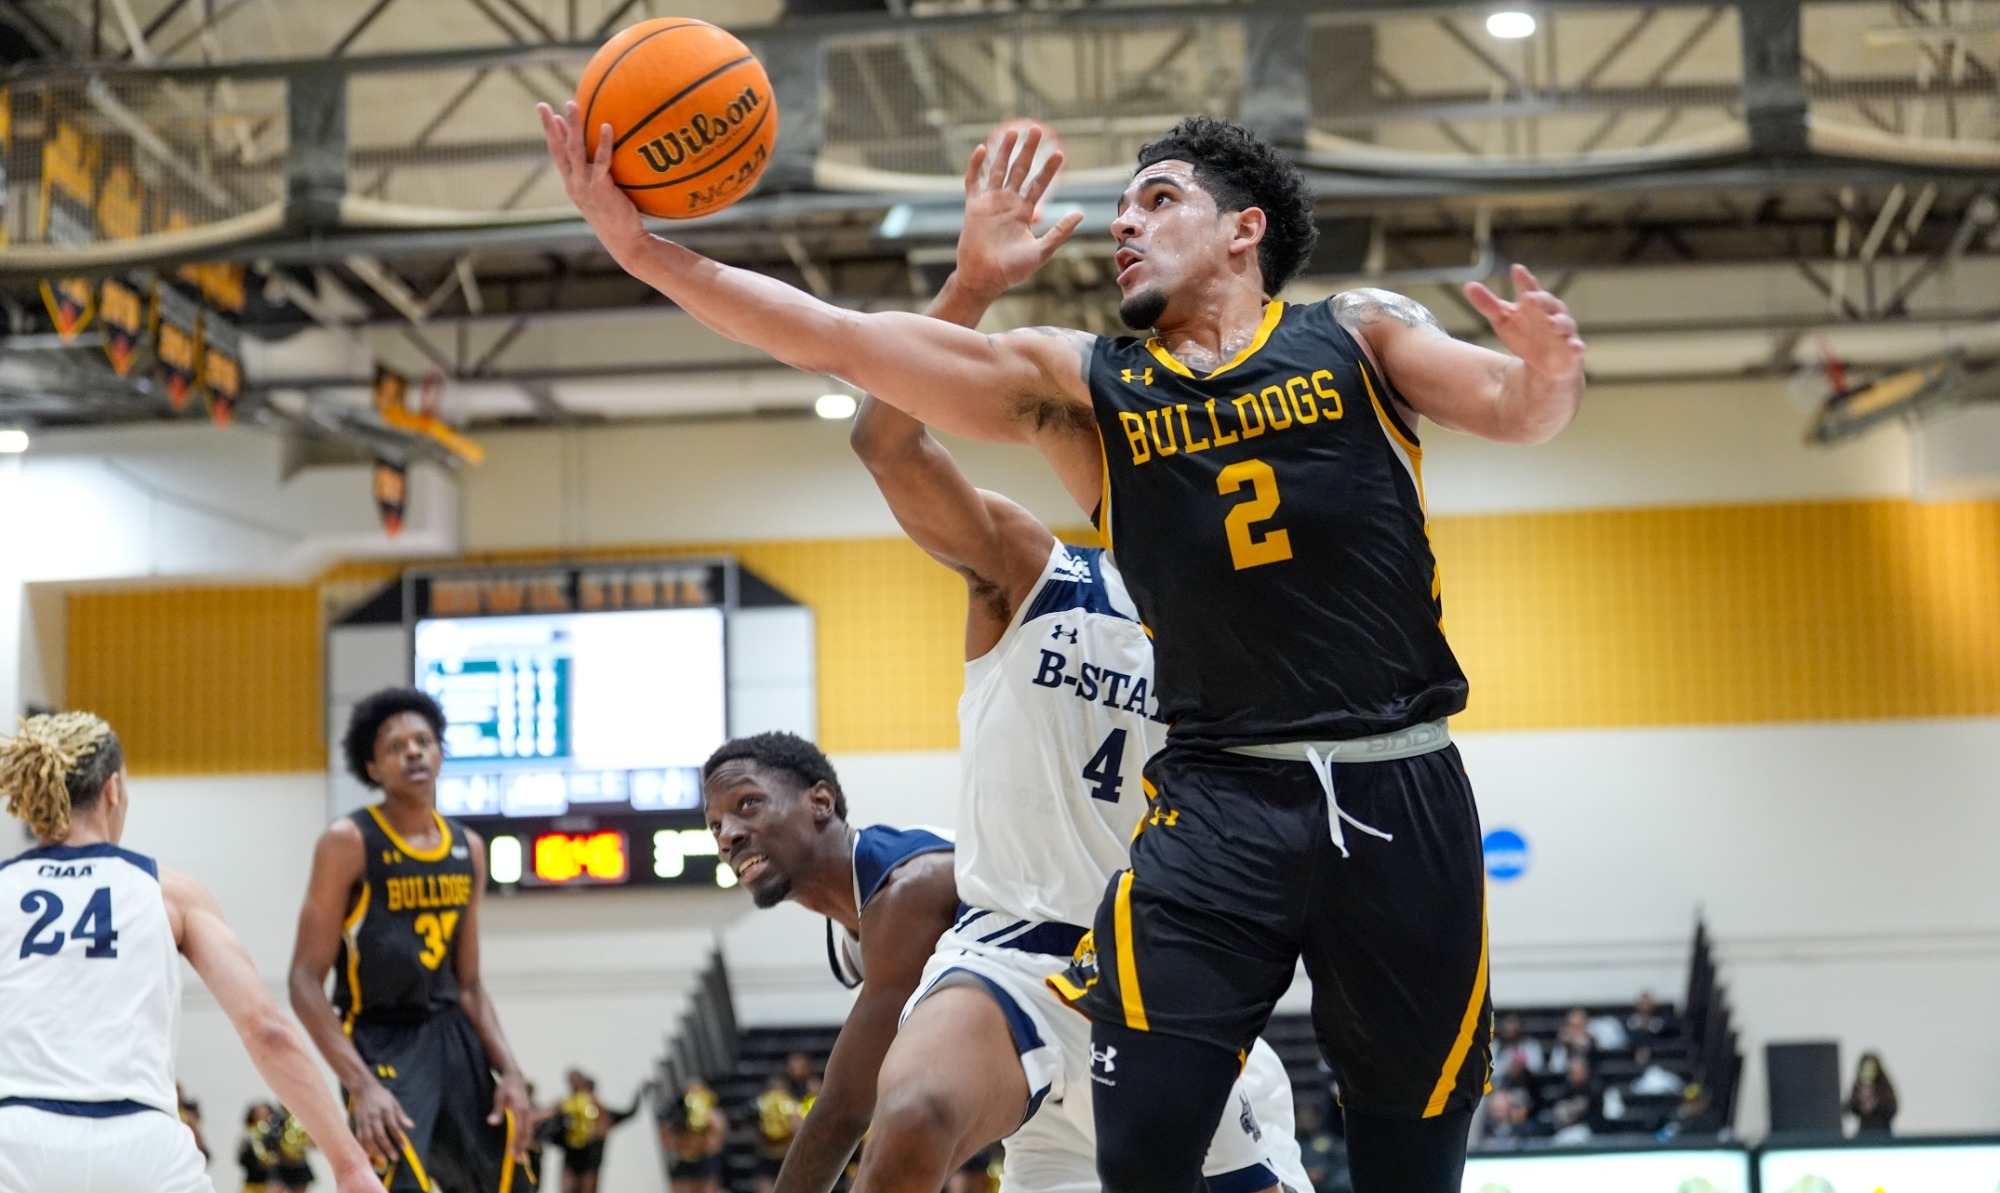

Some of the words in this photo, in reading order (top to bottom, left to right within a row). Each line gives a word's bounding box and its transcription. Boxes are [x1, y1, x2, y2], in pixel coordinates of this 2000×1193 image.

[637, 87, 759, 173] Wilson
[687, 143, 767, 209] NCAA
[1118, 369, 1344, 466] BULLDOGS
[1216, 458, 1293, 571] 2
[1082, 727, 1127, 803] 4
[38, 864, 93, 878] CIAA
[19, 886, 118, 960] 24
